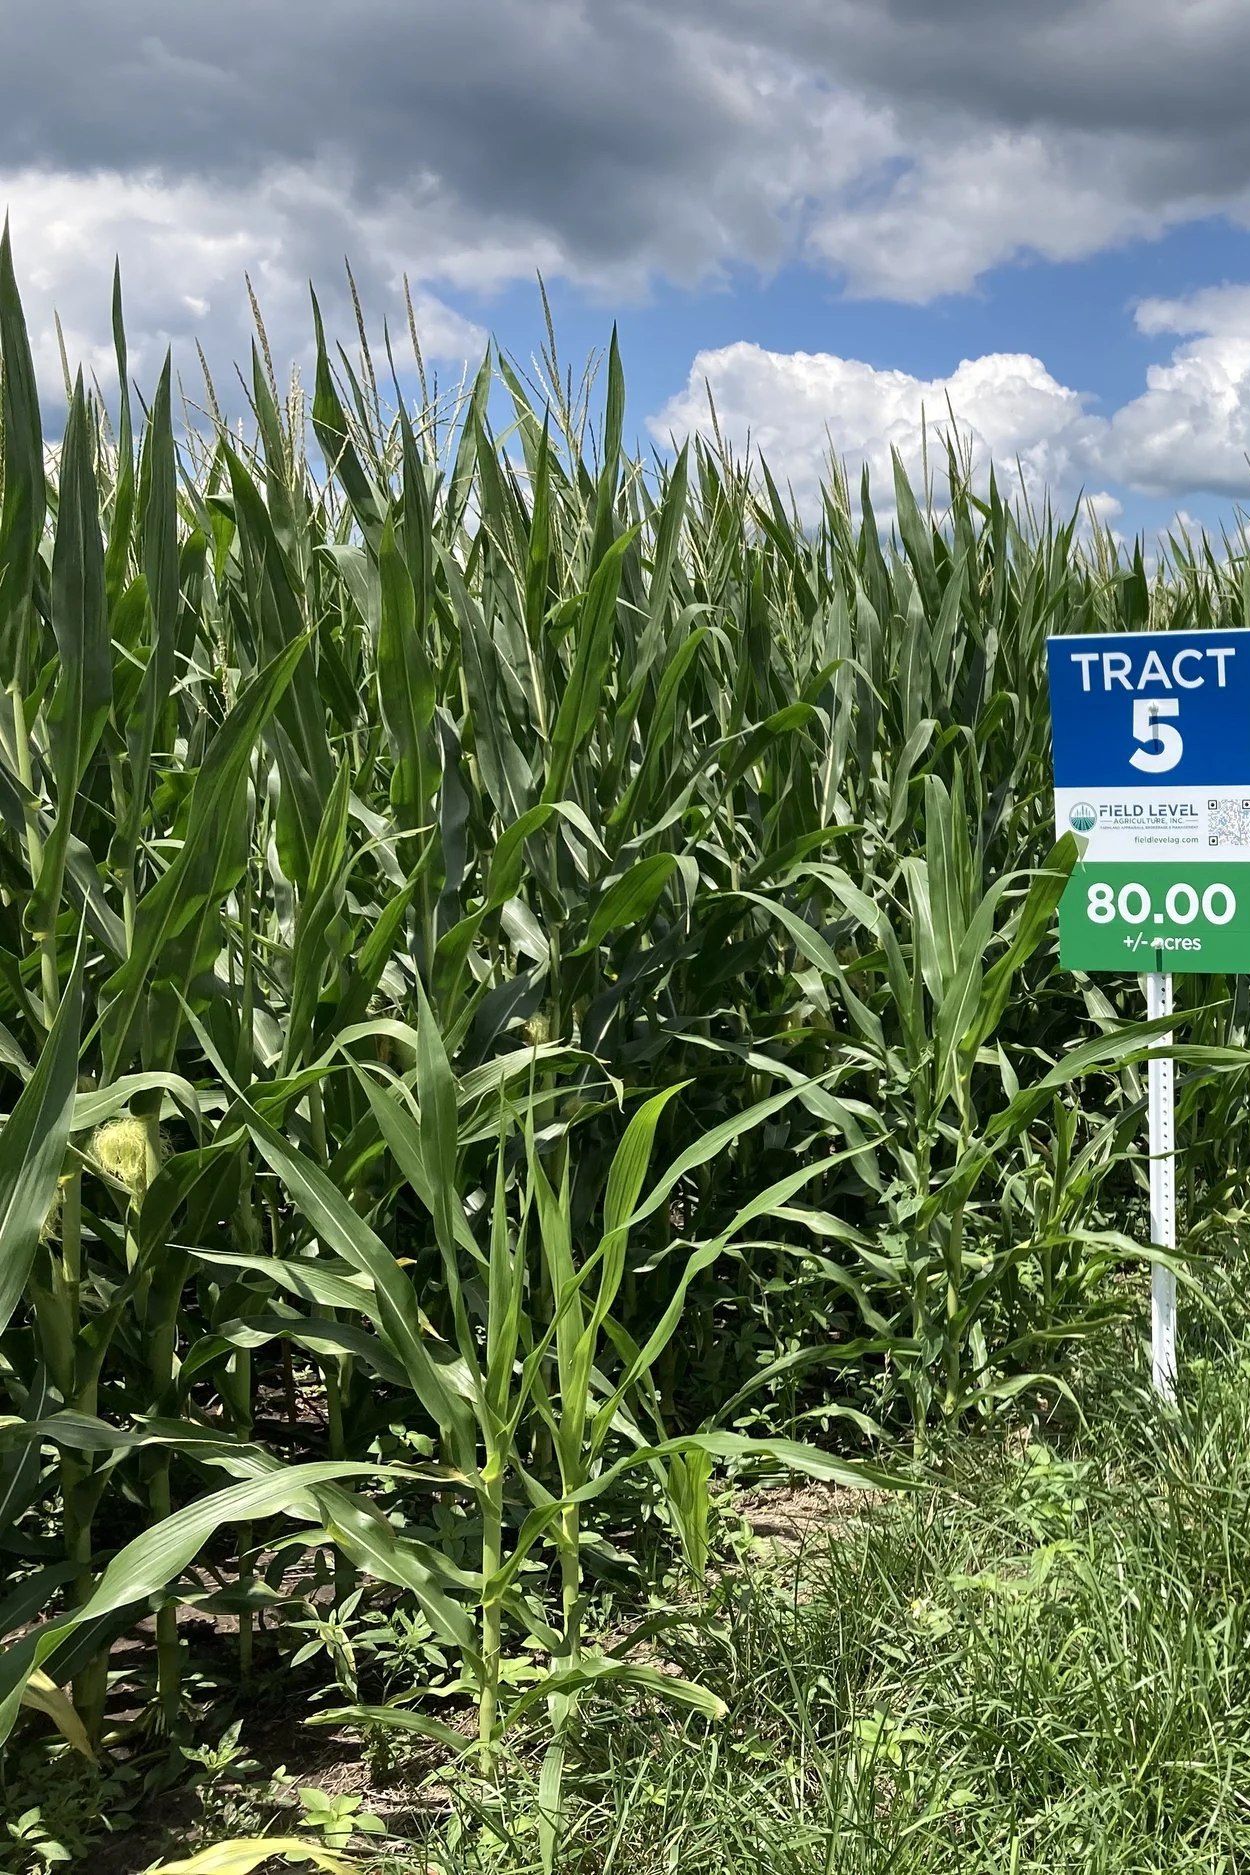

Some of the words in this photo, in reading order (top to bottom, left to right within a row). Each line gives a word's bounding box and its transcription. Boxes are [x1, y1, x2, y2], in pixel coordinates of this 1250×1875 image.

[1070, 647, 1236, 692] TRACT
[1128, 697, 1184, 774] 5
[1099, 804, 1144, 817] FIELD
[1149, 803, 1199, 817] LEVEL
[1113, 817, 1168, 826] AGRICULTURE,
[1134, 836, 1199, 845] fieldlevelag.com
[1086, 882, 1237, 926] 80.00
[1123, 931, 1149, 953] +/-
